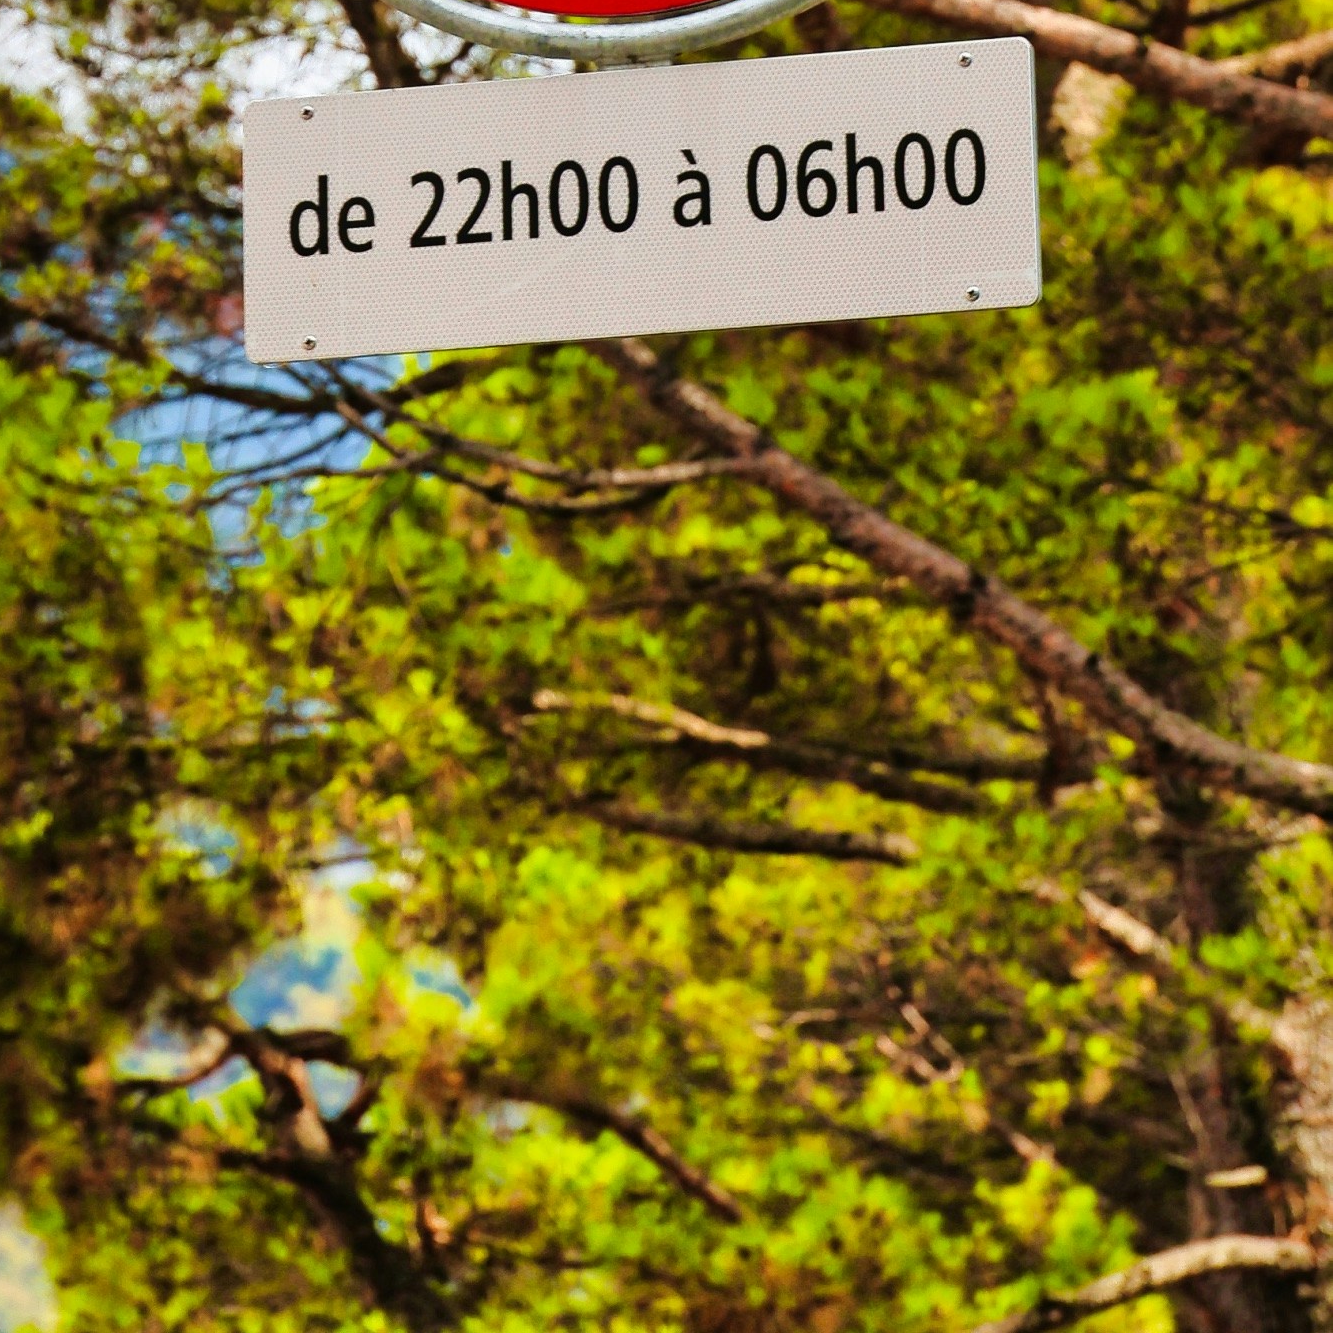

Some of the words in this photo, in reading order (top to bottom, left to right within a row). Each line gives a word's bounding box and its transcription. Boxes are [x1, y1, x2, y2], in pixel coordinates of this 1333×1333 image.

[289, 175, 376, 257] de
[409, 155, 639, 248] 22h00
[673, 149, 712, 227] à
[747, 128, 987, 221] 06h00
